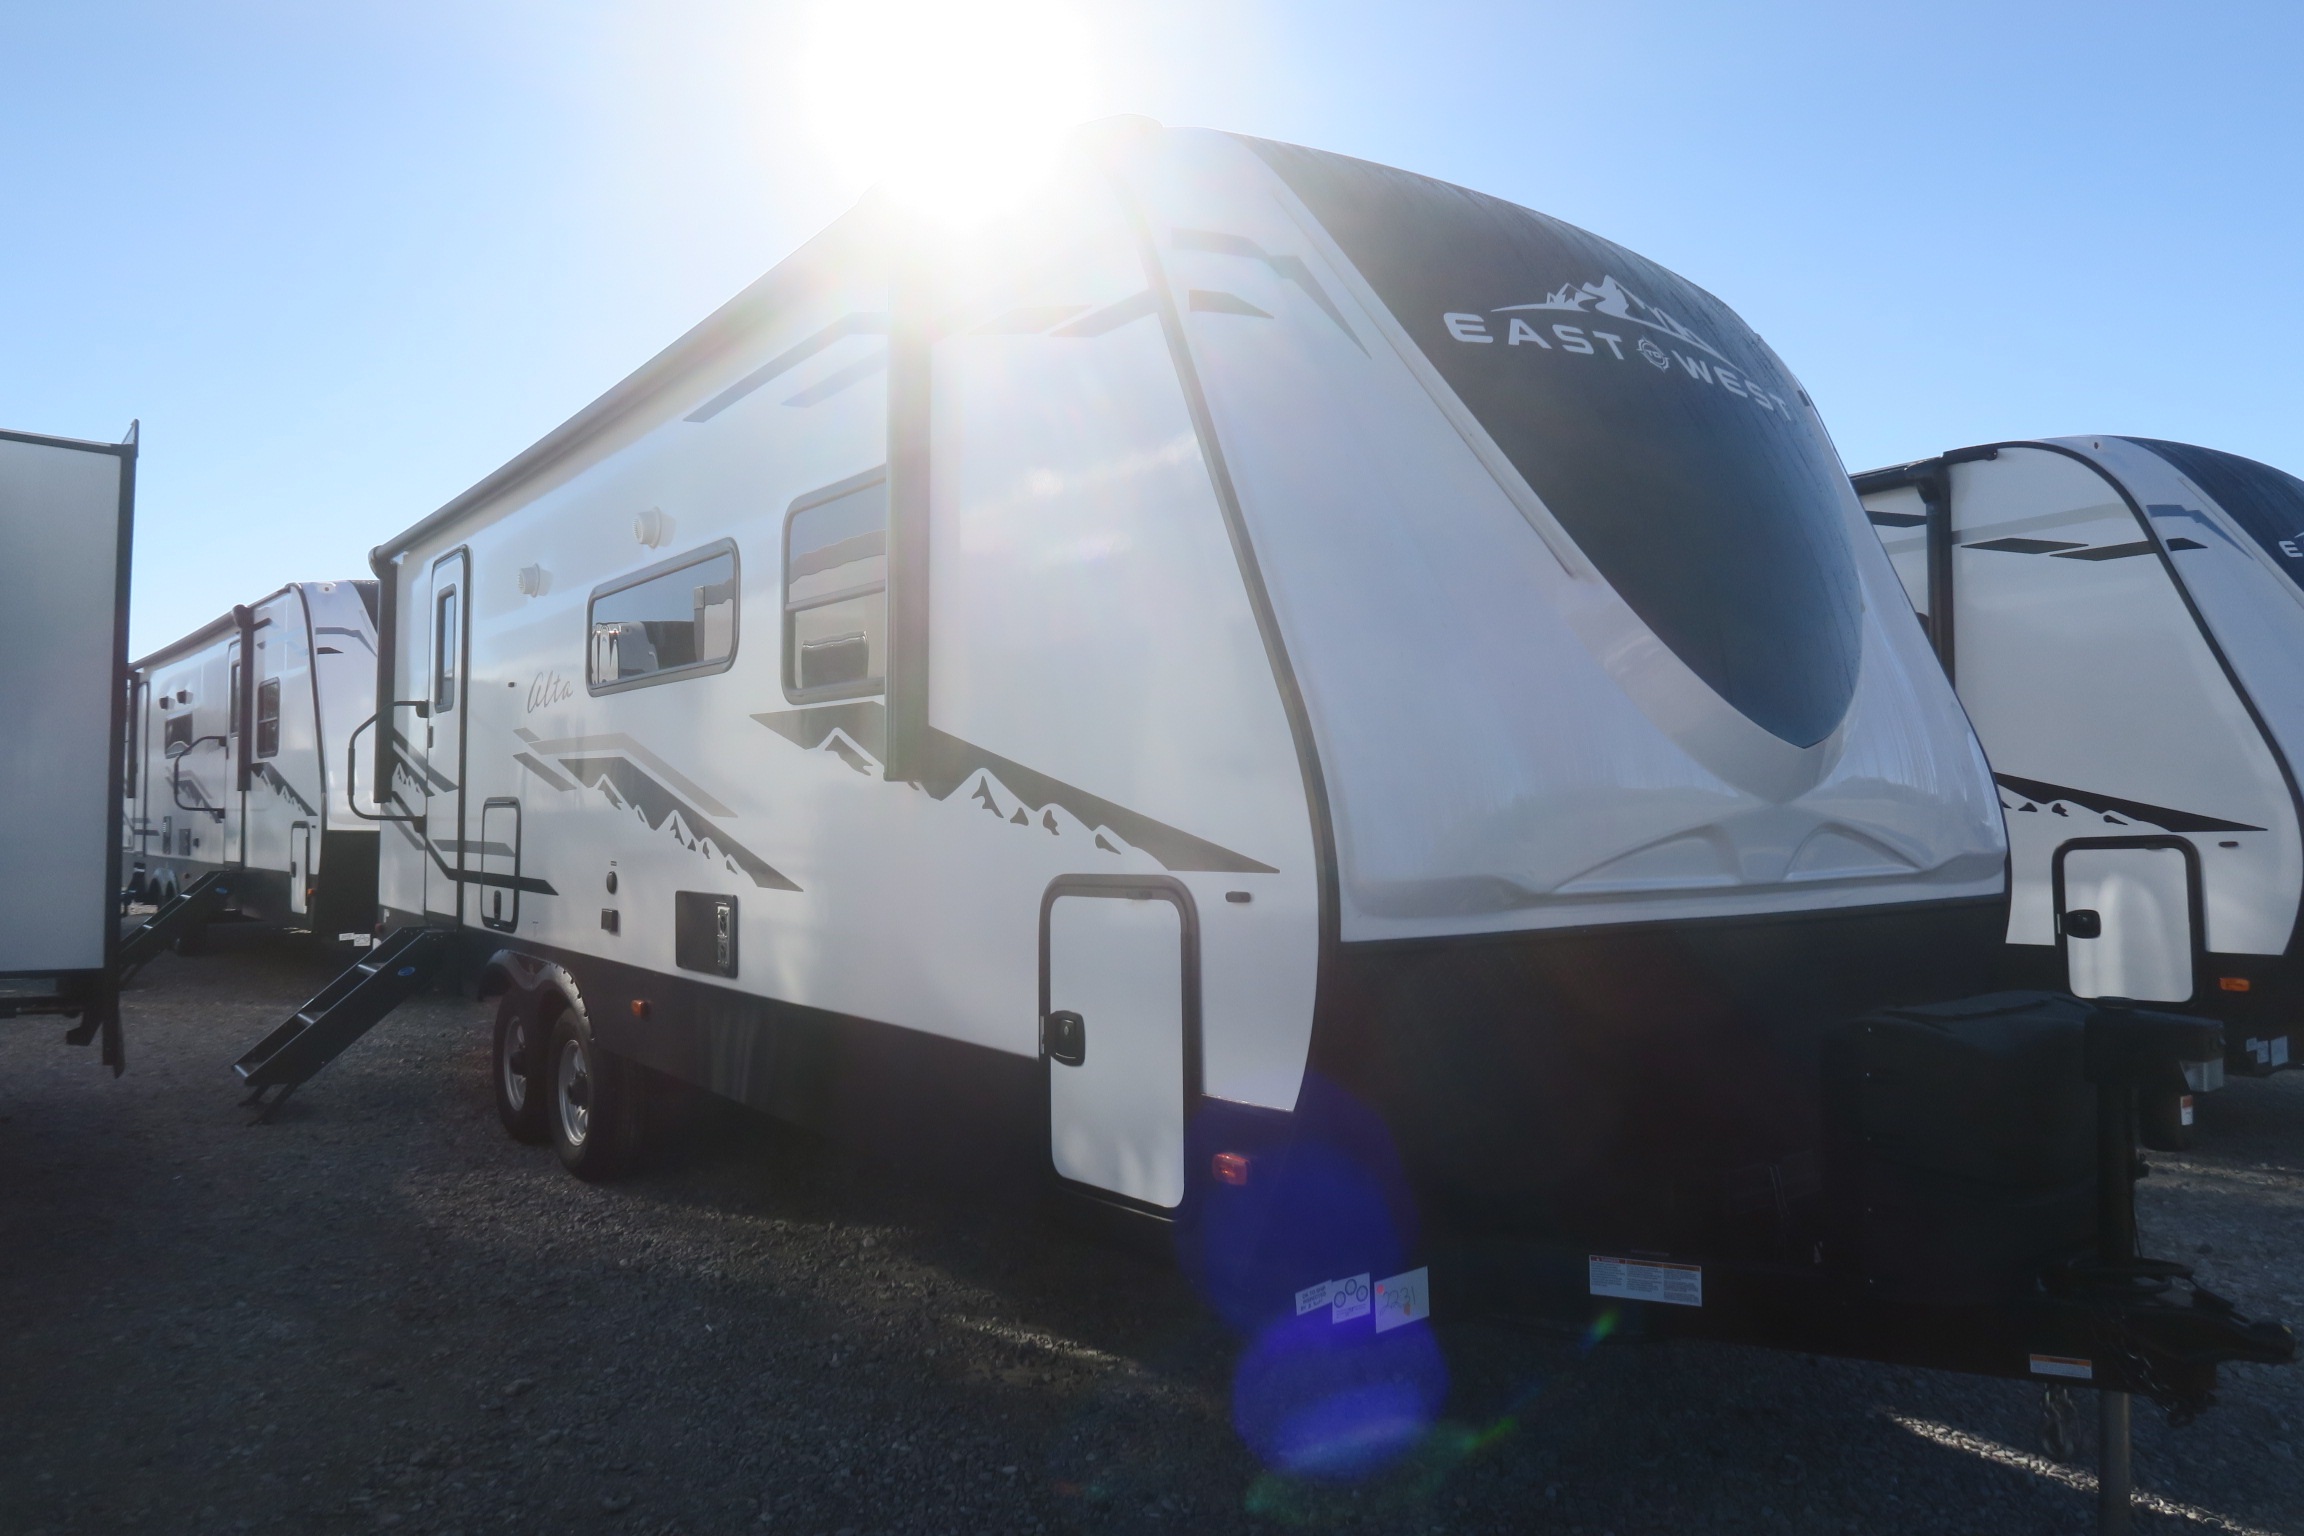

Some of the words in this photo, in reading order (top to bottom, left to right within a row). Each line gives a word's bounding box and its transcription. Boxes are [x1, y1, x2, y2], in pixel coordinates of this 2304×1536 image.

[1443, 312, 1625, 361] EAST
[1671, 349, 1792, 422] WEST
[527, 670, 574, 714] Alta
